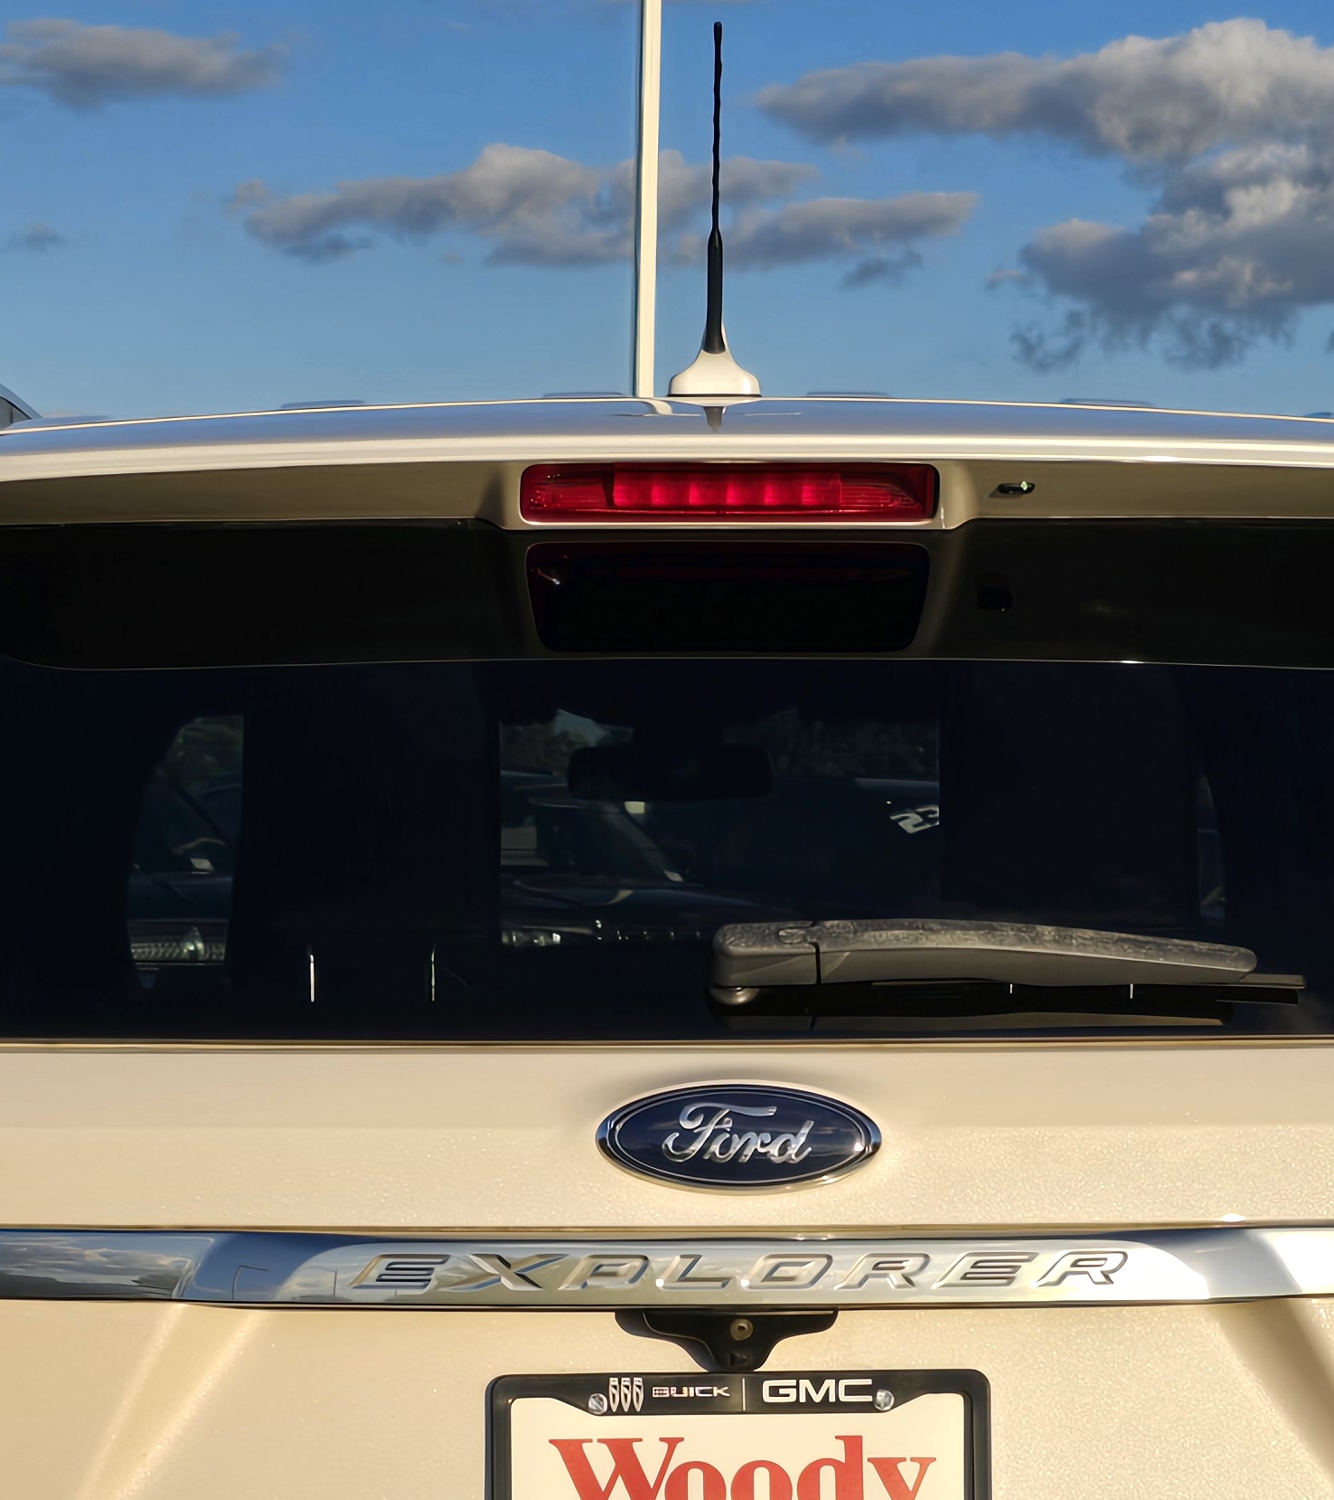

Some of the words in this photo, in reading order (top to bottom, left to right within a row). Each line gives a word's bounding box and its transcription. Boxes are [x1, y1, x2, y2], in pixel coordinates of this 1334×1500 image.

[661, 1101, 815, 1164] Ford
[349, 1250, 1128, 1294] EXPLORER
[651, 1386, 731, 1398] BUICK
[762, 1378, 873, 1403] GMC
